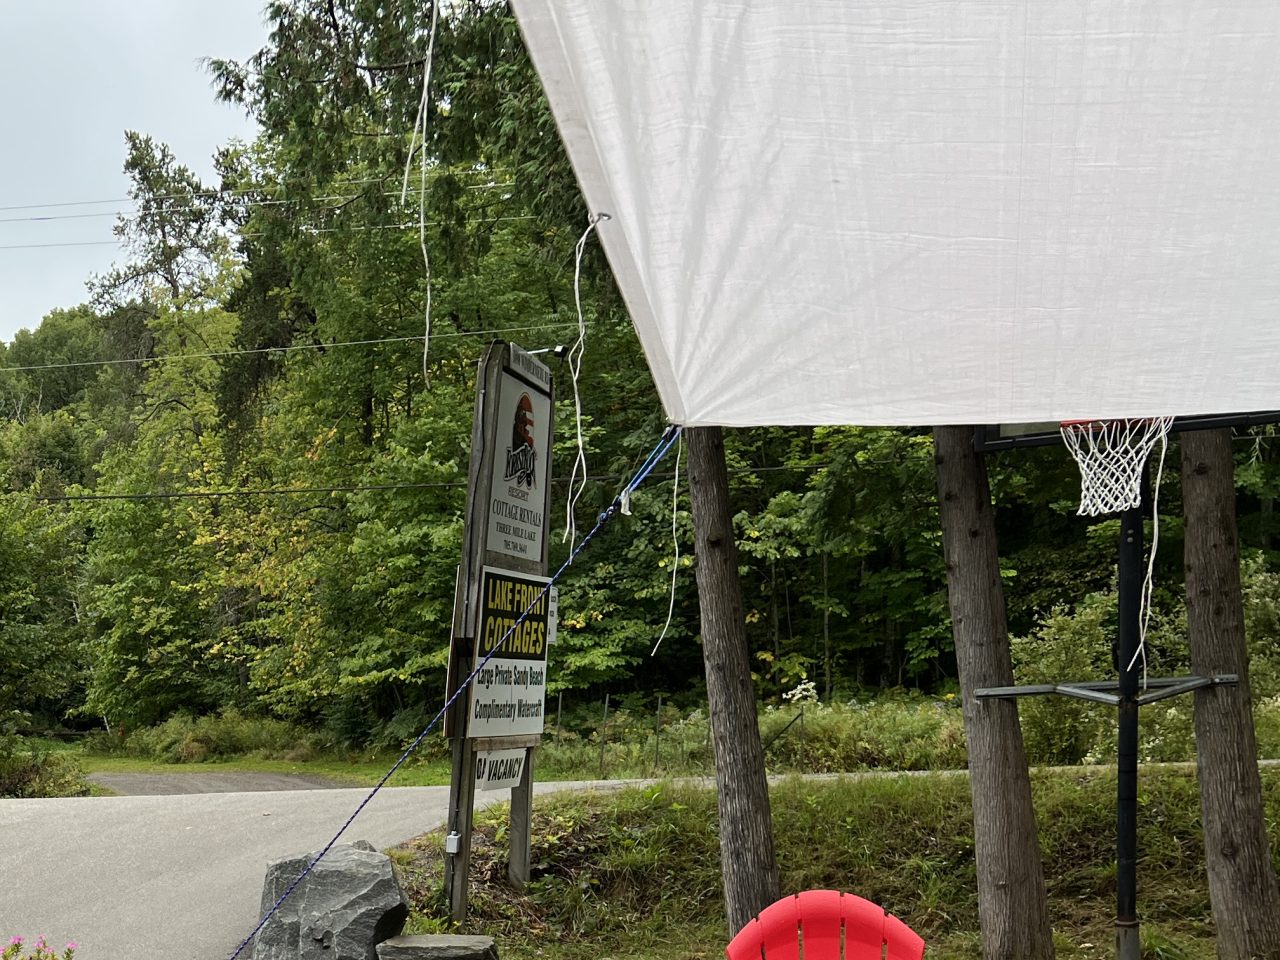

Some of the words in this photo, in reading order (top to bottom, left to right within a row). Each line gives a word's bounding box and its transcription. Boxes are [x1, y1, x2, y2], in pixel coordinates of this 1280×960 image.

[492, 499, 519, 520] COTTAGE
[519, 507, 541, 527] RENTALS
[496, 521, 512, 535] THREE
[524, 530, 536, 541] LAKE
[488, 578, 513, 611] LAKE
[514, 583, 546, 615] FRONT
[484, 616, 545, 654] COTTAGES
[477, 668, 494, 689] Large
[495, 665, 512, 686] Private
[514, 665, 528, 690] Sandy
[529, 666, 543, 686] Beach
[475, 699, 516, 723] Complimentary
[518, 699, 541, 718] Watercraft
[488, 757, 523, 781] VACANCY
